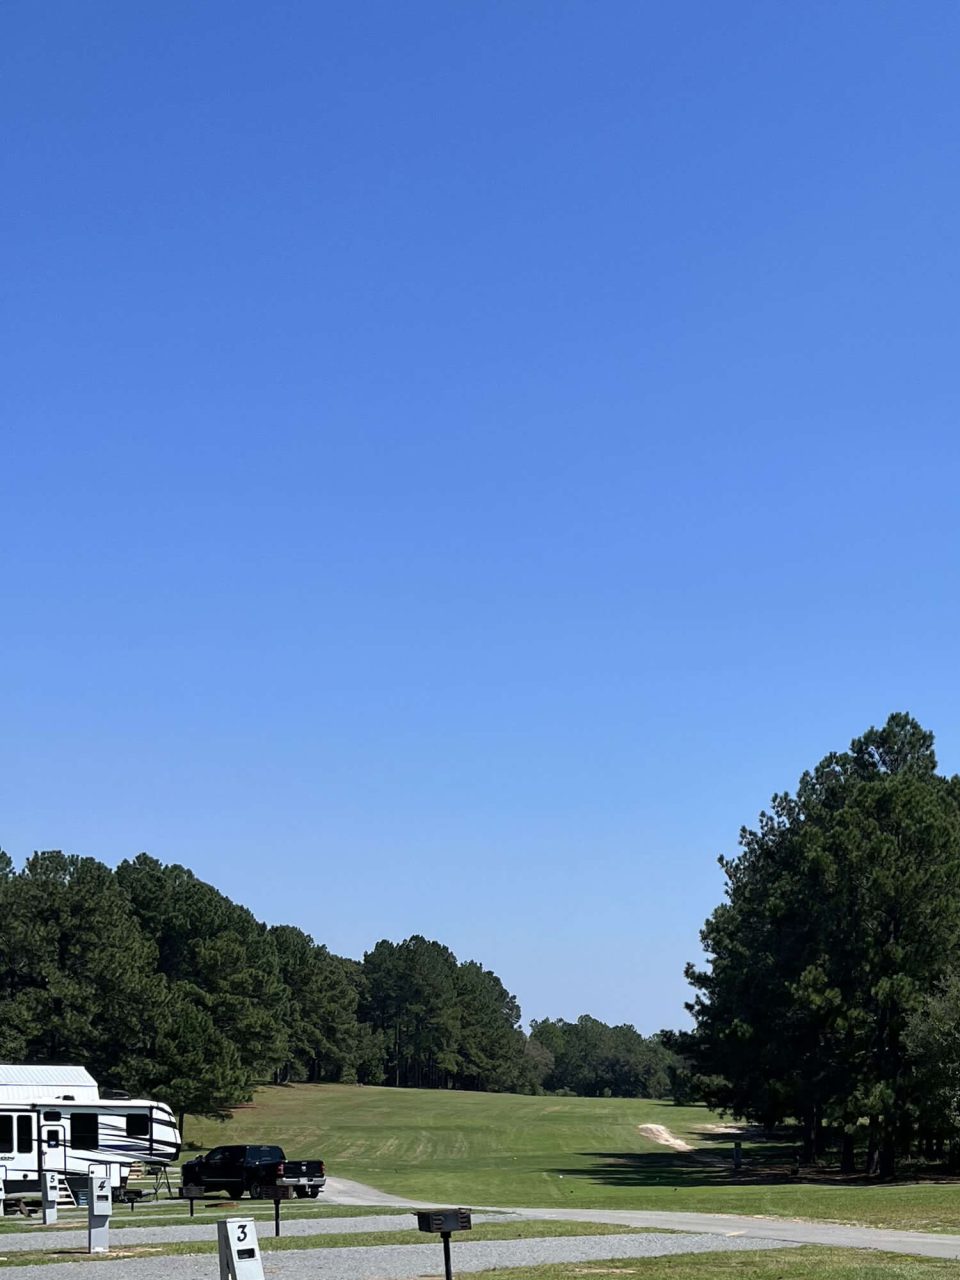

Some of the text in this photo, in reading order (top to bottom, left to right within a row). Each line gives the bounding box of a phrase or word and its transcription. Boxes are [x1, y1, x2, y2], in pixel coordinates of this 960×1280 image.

[50, 1175, 56, 1183] 5
[98, 1180, 106, 1190] 4
[237, 1224, 247, 1241] 3
